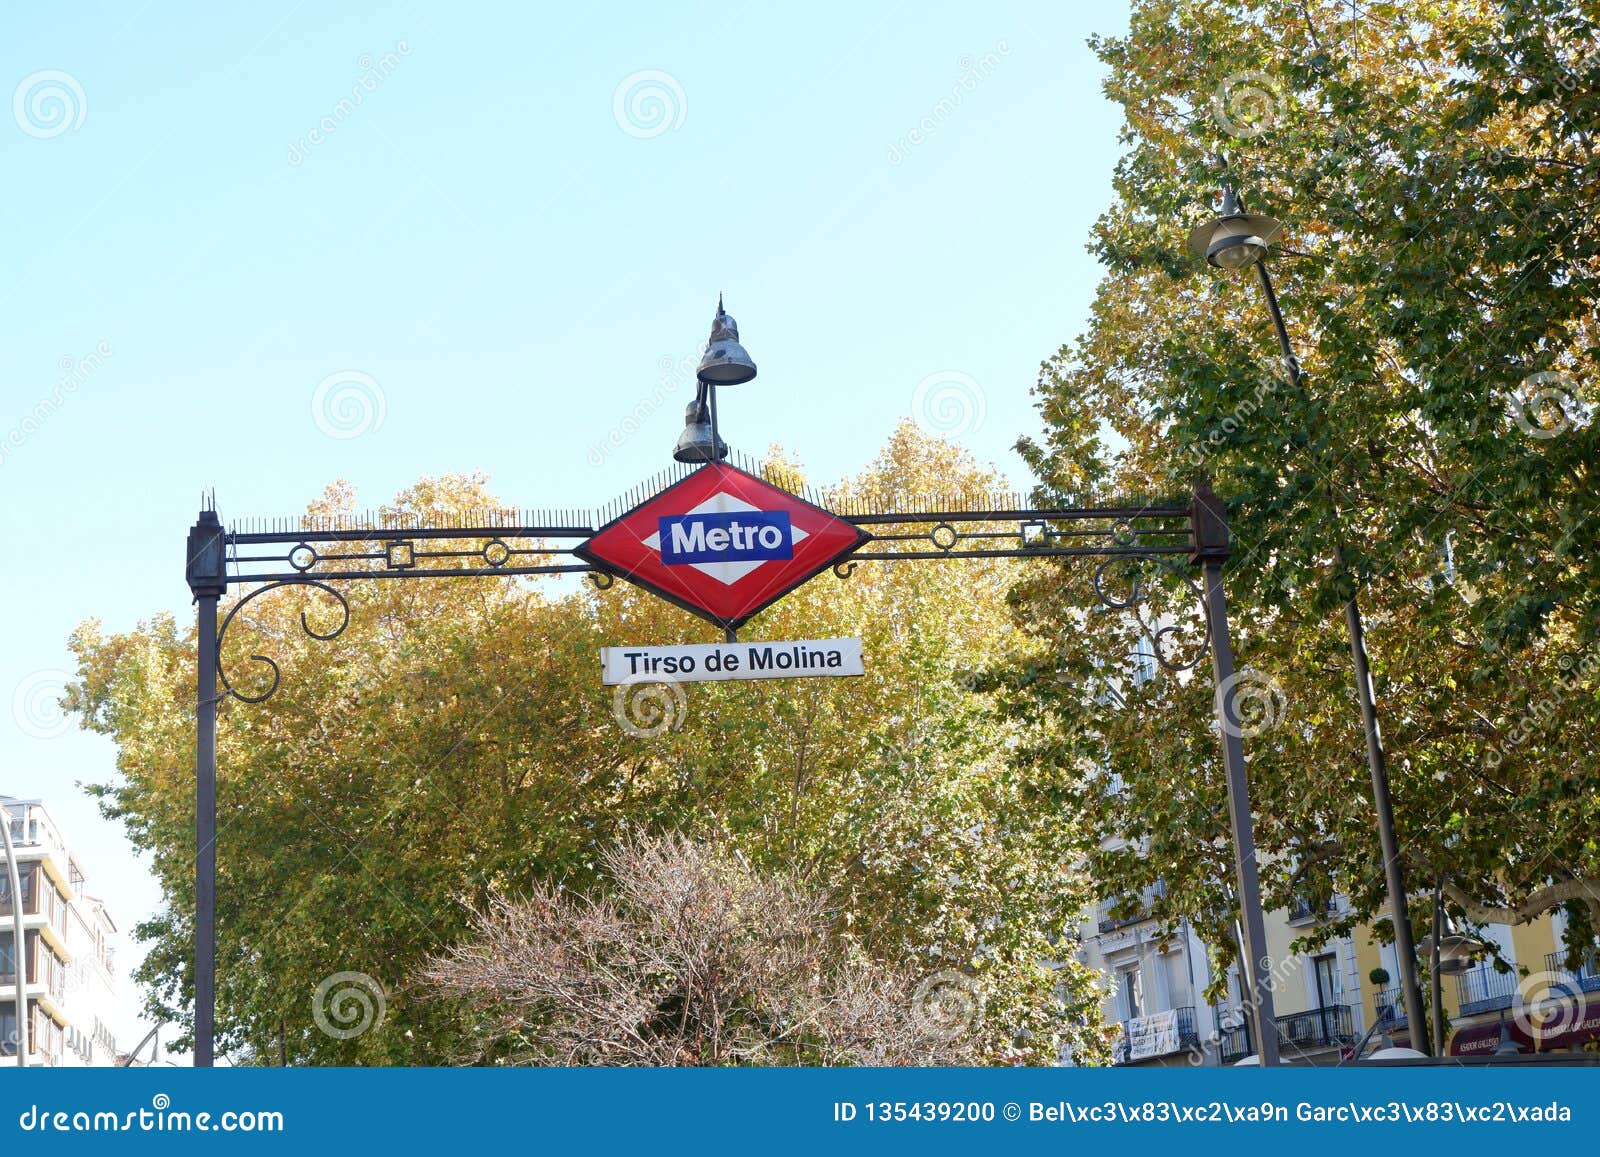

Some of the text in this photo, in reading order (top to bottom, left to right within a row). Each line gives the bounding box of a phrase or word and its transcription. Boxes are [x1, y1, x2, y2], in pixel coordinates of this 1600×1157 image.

[670, 521, 783, 554] Metro
[624, 646, 842, 675] Tirso de Molina
